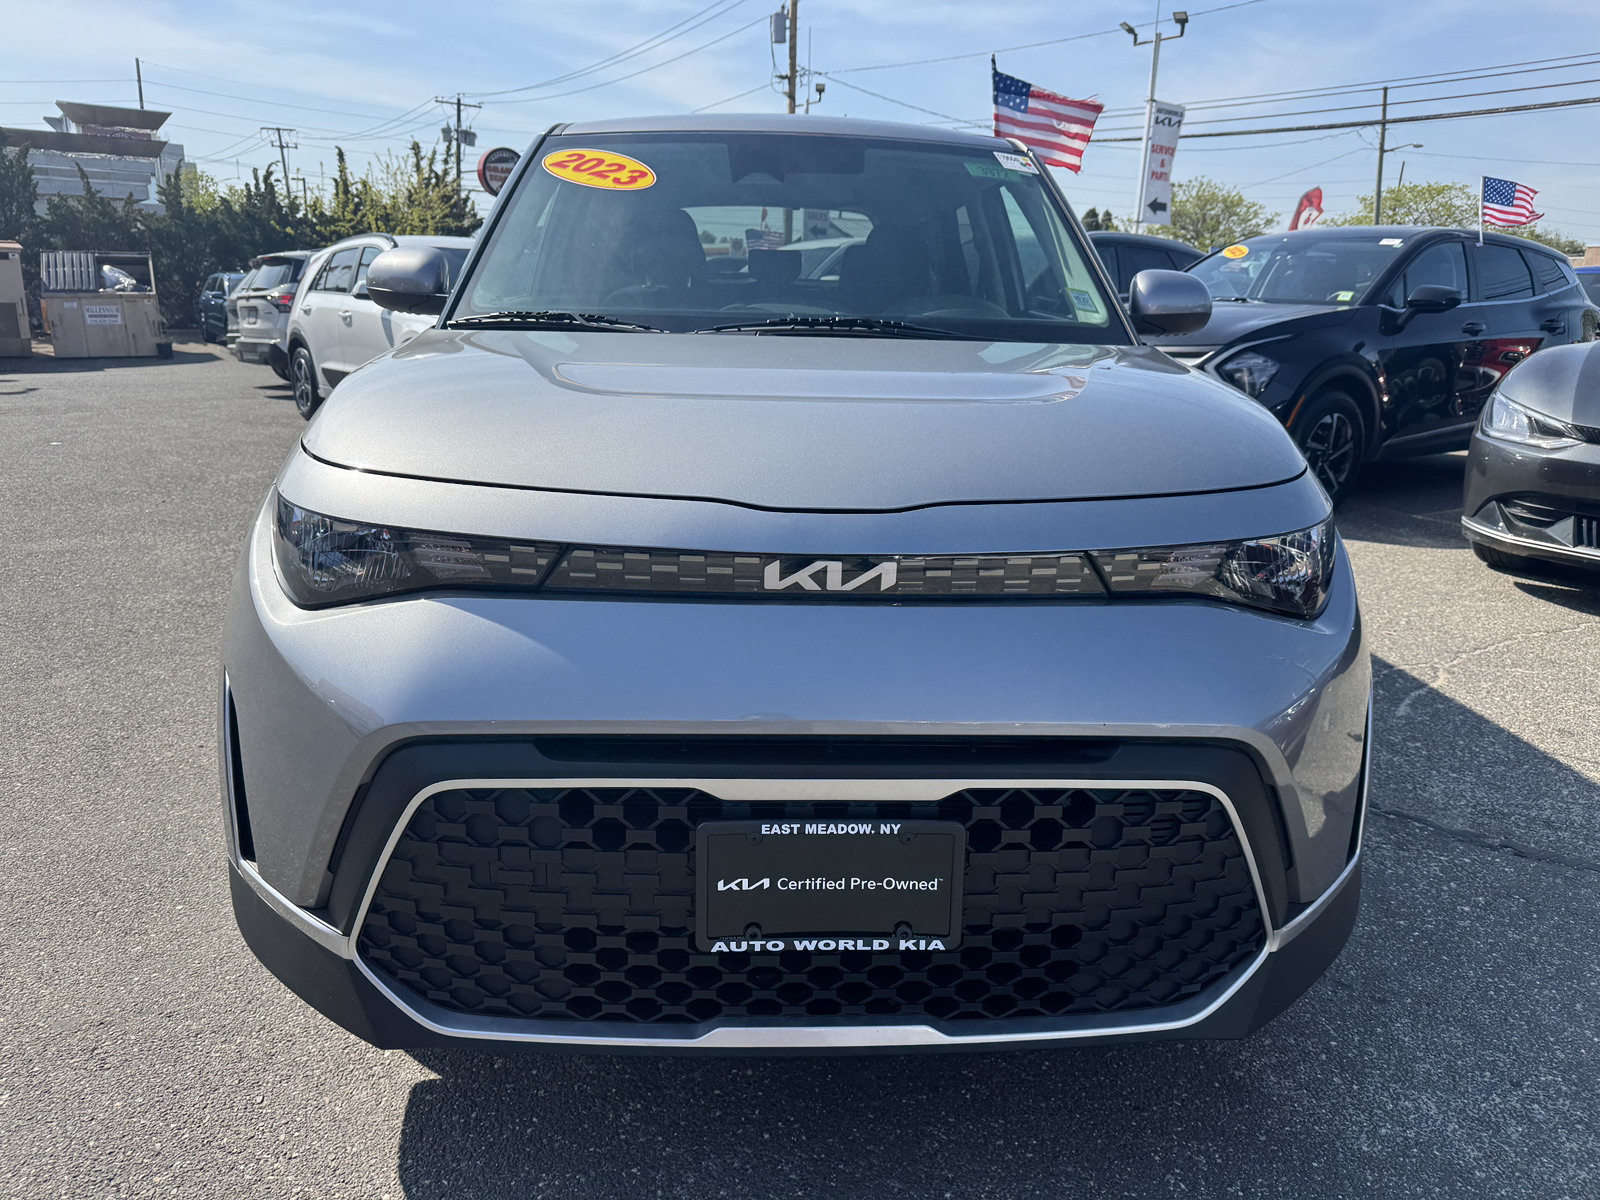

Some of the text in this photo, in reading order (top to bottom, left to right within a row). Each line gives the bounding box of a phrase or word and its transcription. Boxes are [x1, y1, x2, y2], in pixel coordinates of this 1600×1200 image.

[1155, 115, 1182, 128] KIA
[1151, 143, 1176, 156] SERVICE
[486, 164, 513, 174] GRAN
[549, 153, 649, 185] 2023
[1160, 158, 1166, 168] &
[764, 559, 898, 592] KIA
[761, 823, 801, 835] EAST
[879, 823, 902, 835] NY
[717, 877, 770, 891] KIA
[776, 877, 845, 891] Certified
[710, 938, 946, 953] AUTO WORLD KIA
